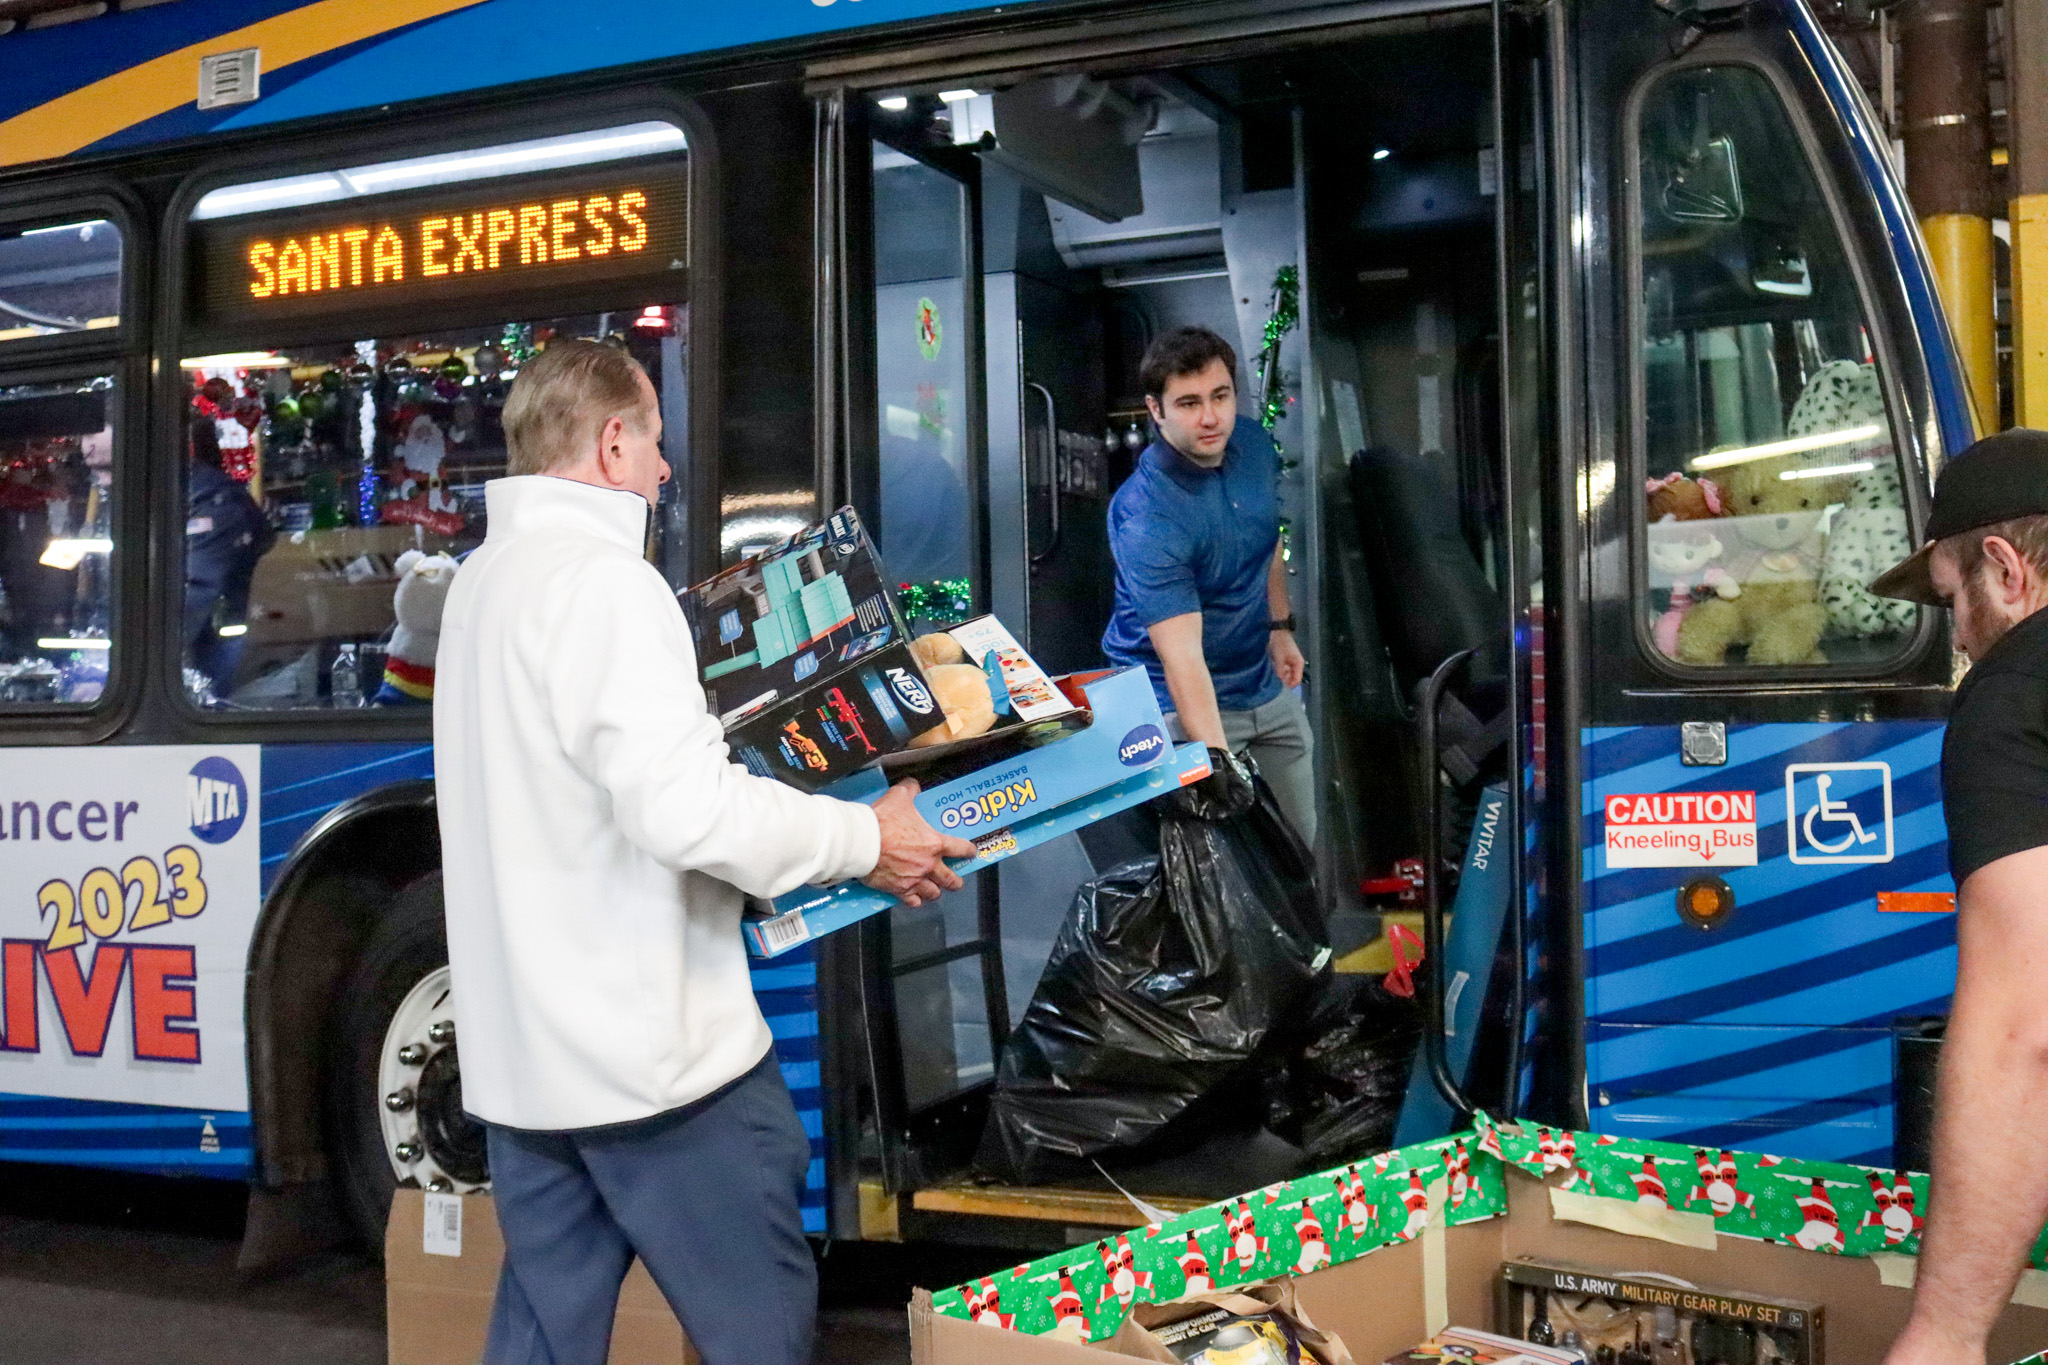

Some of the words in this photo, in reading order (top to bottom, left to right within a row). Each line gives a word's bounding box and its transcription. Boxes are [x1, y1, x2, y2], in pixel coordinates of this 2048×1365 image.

[250, 226, 404, 298] SANTA
[421, 192, 648, 277] EXPRESS
[884, 667, 935, 713] NERF
[1120, 735, 1164, 761] vtech
[187, 773, 240, 828] MTA
[934, 790, 963, 808] HOOP
[940, 778, 1038, 830] KidiGo
[963, 765, 1028, 799] BASKETBALL
[0, 800, 139, 842] ncer
[1608, 794, 1754, 824] CAUTION
[1473, 801, 1501, 870] VIVITAR
[1608, 830, 1701, 852] Kneeling
[1713, 829, 1755, 847] Bus
[37, 844, 208, 954] 2023
[0, 937, 202, 1064] IVE
[1554, 1274, 1578, 1291] U.S.
[1581, 1278, 1616, 1297] ARMY
[1622, 1285, 1681, 1306] MILITARY
[1683, 1295, 1716, 1315] GEAR
[1720, 1301, 1753, 1320] PLAY
[1757, 1306, 1783, 1324] SET
[1159, 1331, 1188, 1346] OBOT
[1199, 1322, 1217, 1333] CAR
